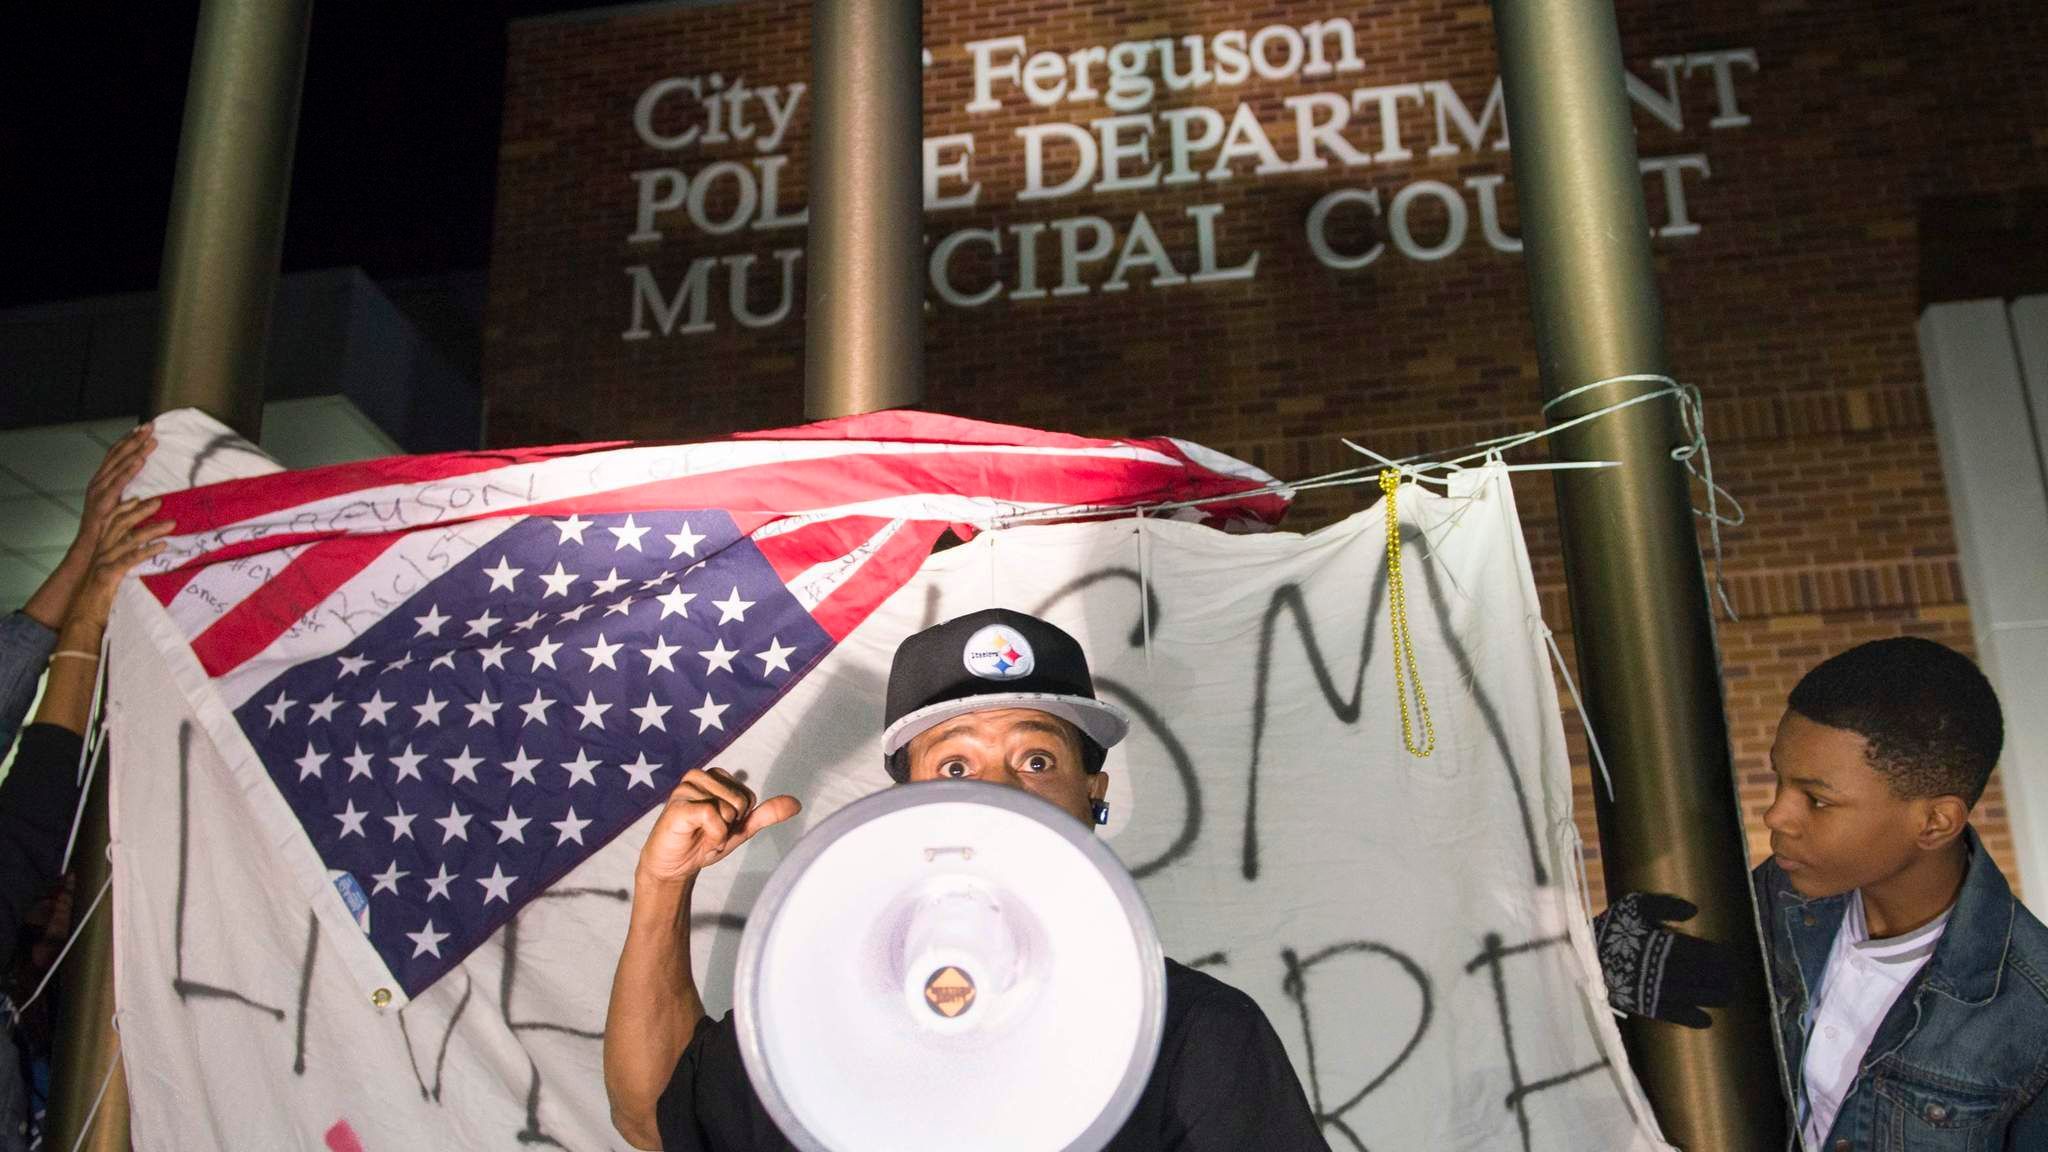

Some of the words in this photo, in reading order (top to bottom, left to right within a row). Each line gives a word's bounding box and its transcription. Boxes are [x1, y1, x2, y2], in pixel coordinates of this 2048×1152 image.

[627, 132, 981, 244] POLE
[1015, 47, 1760, 201] DEPARTMNT
[633, 72, 807, 151] City
[965, 15, 1366, 112] Ferguson
[622, 203, 1260, 341] MUCIPAL
[1305, 152, 1712, 270] COUT
